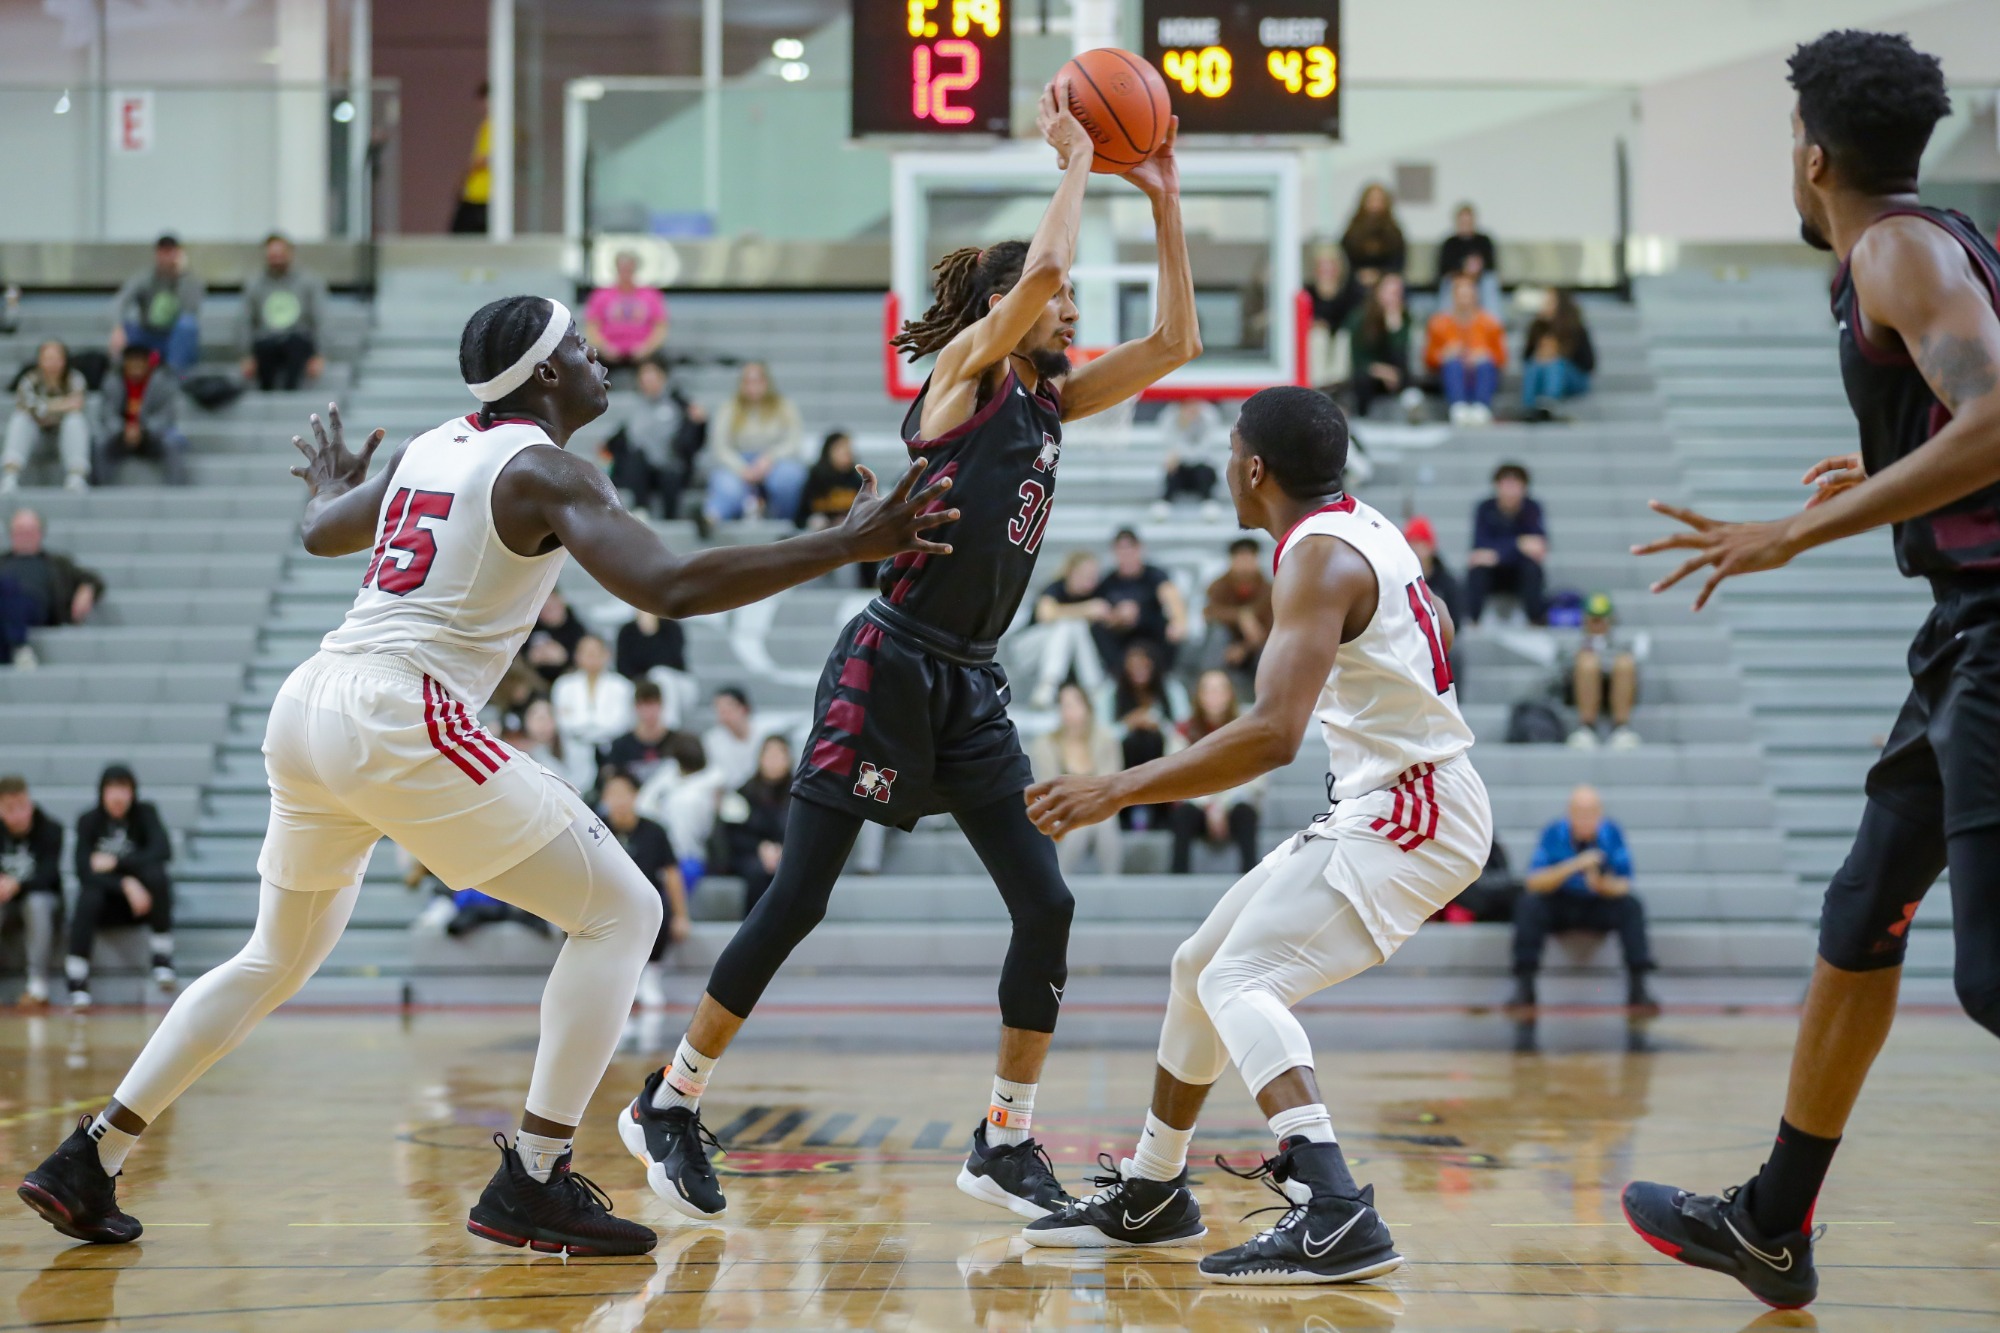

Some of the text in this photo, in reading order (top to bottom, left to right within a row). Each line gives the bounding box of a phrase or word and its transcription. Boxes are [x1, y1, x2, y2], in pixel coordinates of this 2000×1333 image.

[913, 40, 980, 124] 12
[1163, 46, 1336, 98] 40 43
[122, 98, 144, 152] E
[362, 487, 455, 597] 15
[1008, 478, 1055, 554] 31
